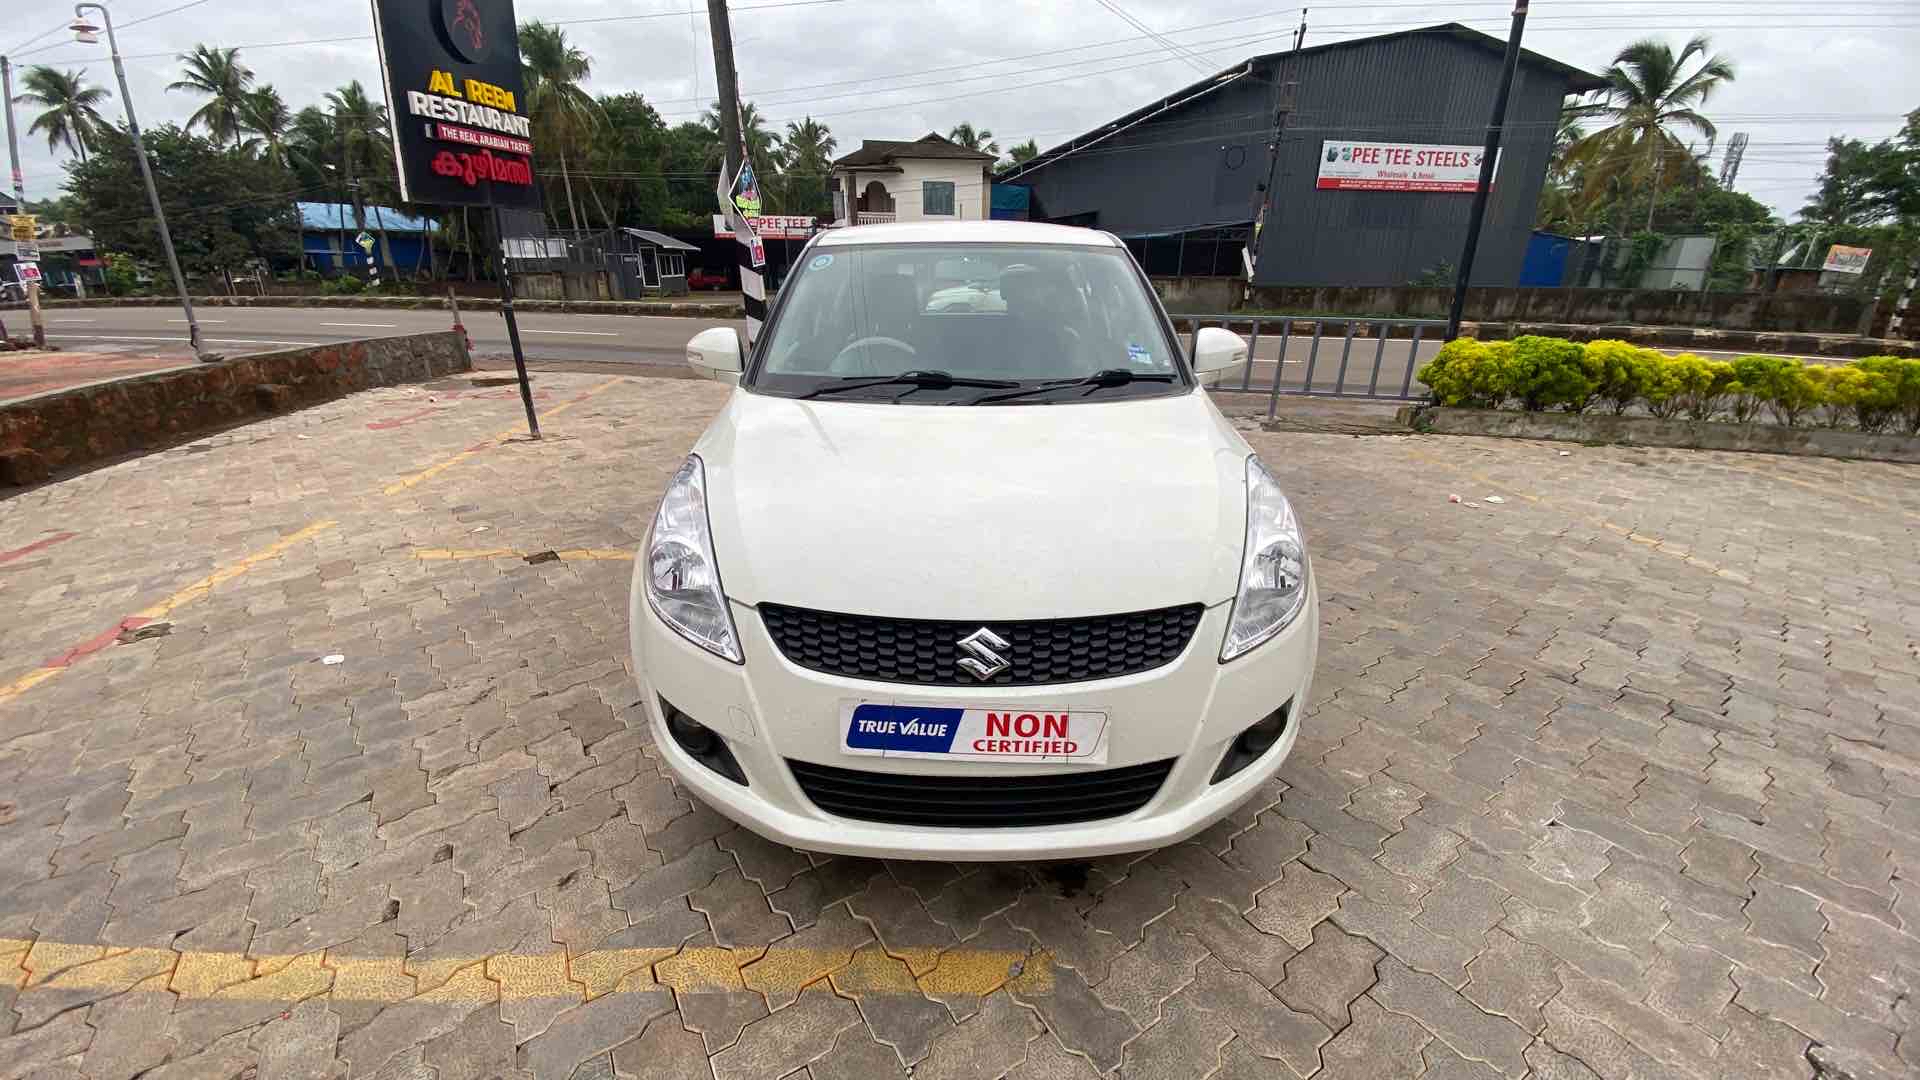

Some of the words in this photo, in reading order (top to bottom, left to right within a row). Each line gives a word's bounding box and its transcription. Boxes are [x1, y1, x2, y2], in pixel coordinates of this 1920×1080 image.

[428, 69, 463, 98] AL
[463, 79, 517, 112] REEM
[407, 90, 531, 138] RESTAURANT
[441, 126, 459, 140] THE
[459, 130, 480, 145] REAL
[479, 135, 510, 150] ARABIAN
[509, 140, 531, 153] TASTE
[1351, 146, 1380, 165] PEE
[1384, 148, 1413, 166] TEE
[1415, 150, 1470, 168] STEELS
[759, 217, 781, 229] PEE
[784, 218, 807, 229] TEE
[858, 719, 897, 735] TRUE
[899, 717, 948, 738] VALUE
[986, 712, 1069, 739] NON
[972, 739, 1078, 755] CERTIFIED
